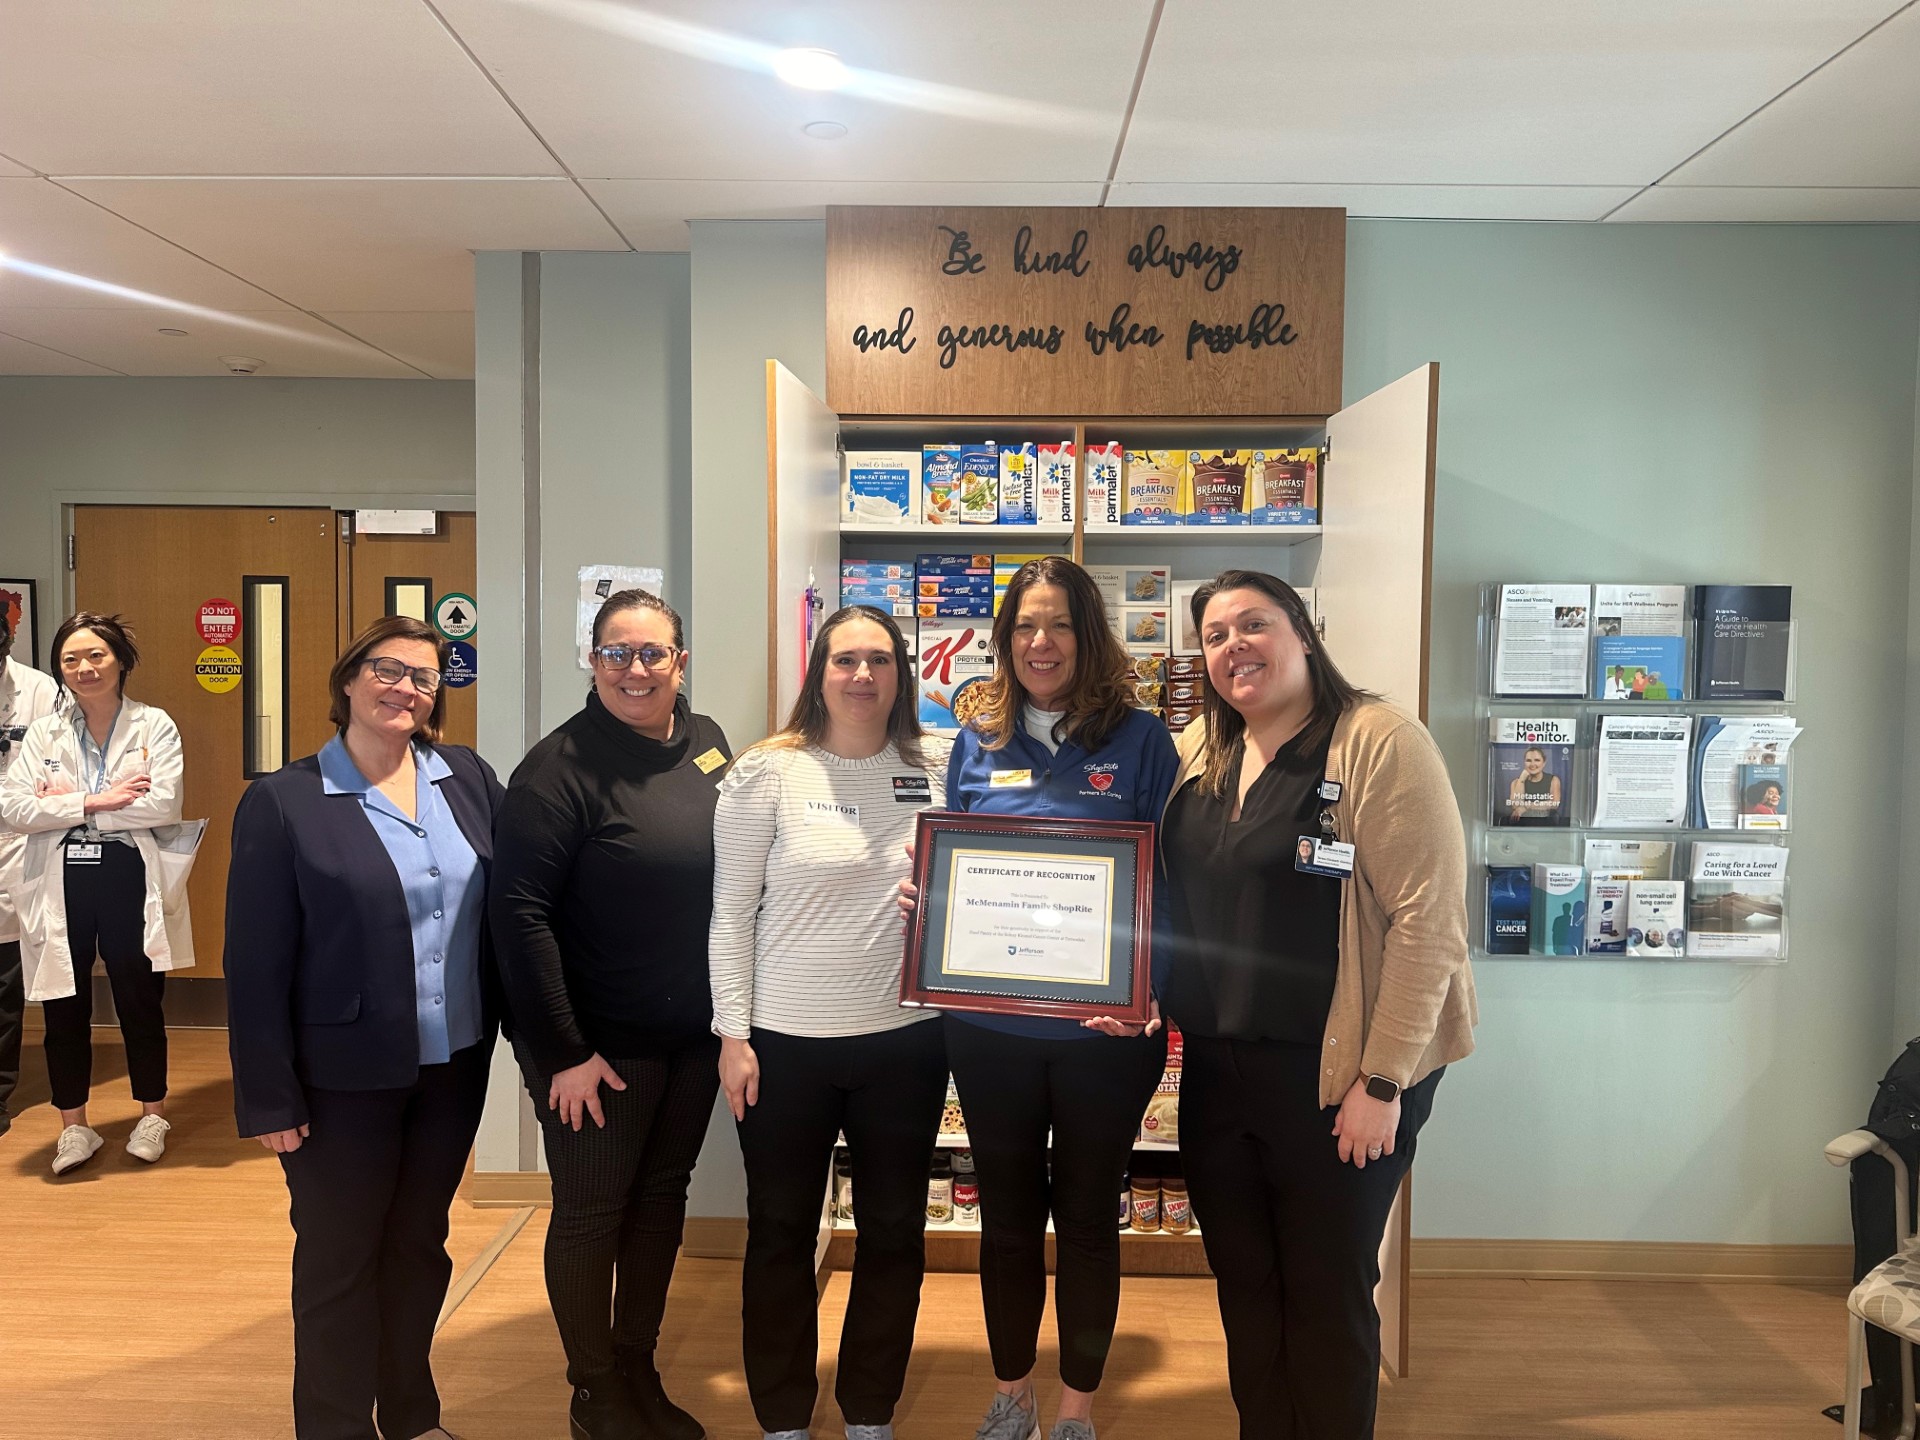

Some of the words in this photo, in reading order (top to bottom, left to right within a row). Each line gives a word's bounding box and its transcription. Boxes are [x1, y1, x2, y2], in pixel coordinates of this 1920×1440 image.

[938, 225, 985, 275] Be
[1013, 225, 1089, 277] kind
[1127, 224, 1242, 291] always
[853, 307, 916, 353] and
[937, 323, 1064, 369] generous
[1085, 303, 1164, 354] when
[1187, 303, 1298, 360] possible
[925, 461, 959, 473] Almond
[931, 469, 954, 478] Breeze
[1196, 484, 1242, 496] BREAKFAST
[1265, 479, 1305, 490] BREAKFAST
[1022, 463, 1034, 520] parmalat
[1042, 487, 1060, 495] Milk
[1060, 464, 1072, 522] parmalat
[1088, 488, 1106, 496] Milk
[1106, 465, 1118, 523] parmalat
[1131, 485, 1175, 496] BREAKFAST
[202, 607, 214, 615] DO
[217, 607, 235, 615] NOT
[1714, 630, 1729, 638] Care
[1730, 630, 1765, 638] Directives
[921, 628, 975, 686] K
[197, 665, 240, 674] CAUTION
[1516, 721, 1559, 732] Health
[1083, 763, 1119, 773] ShopRite
[1107, 791, 1122, 800] Caring
[1514, 792, 1554, 800] Metastatic
[808, 802, 857, 815] VISITOR
[1705, 861, 1731, 869] Caring
[1732, 861, 1745, 869] for
[1752, 861, 1778, 869] Loved
[967, 867, 1021, 877] CERTIFICATE
[1036, 871, 1096, 881] RECOGNITION
[966, 899, 1020, 908] McMenamin
[1021, 901, 1051, 910] Family
[1052, 903, 1093, 913] ShopRite
[1496, 925, 1527, 933] CANCER
